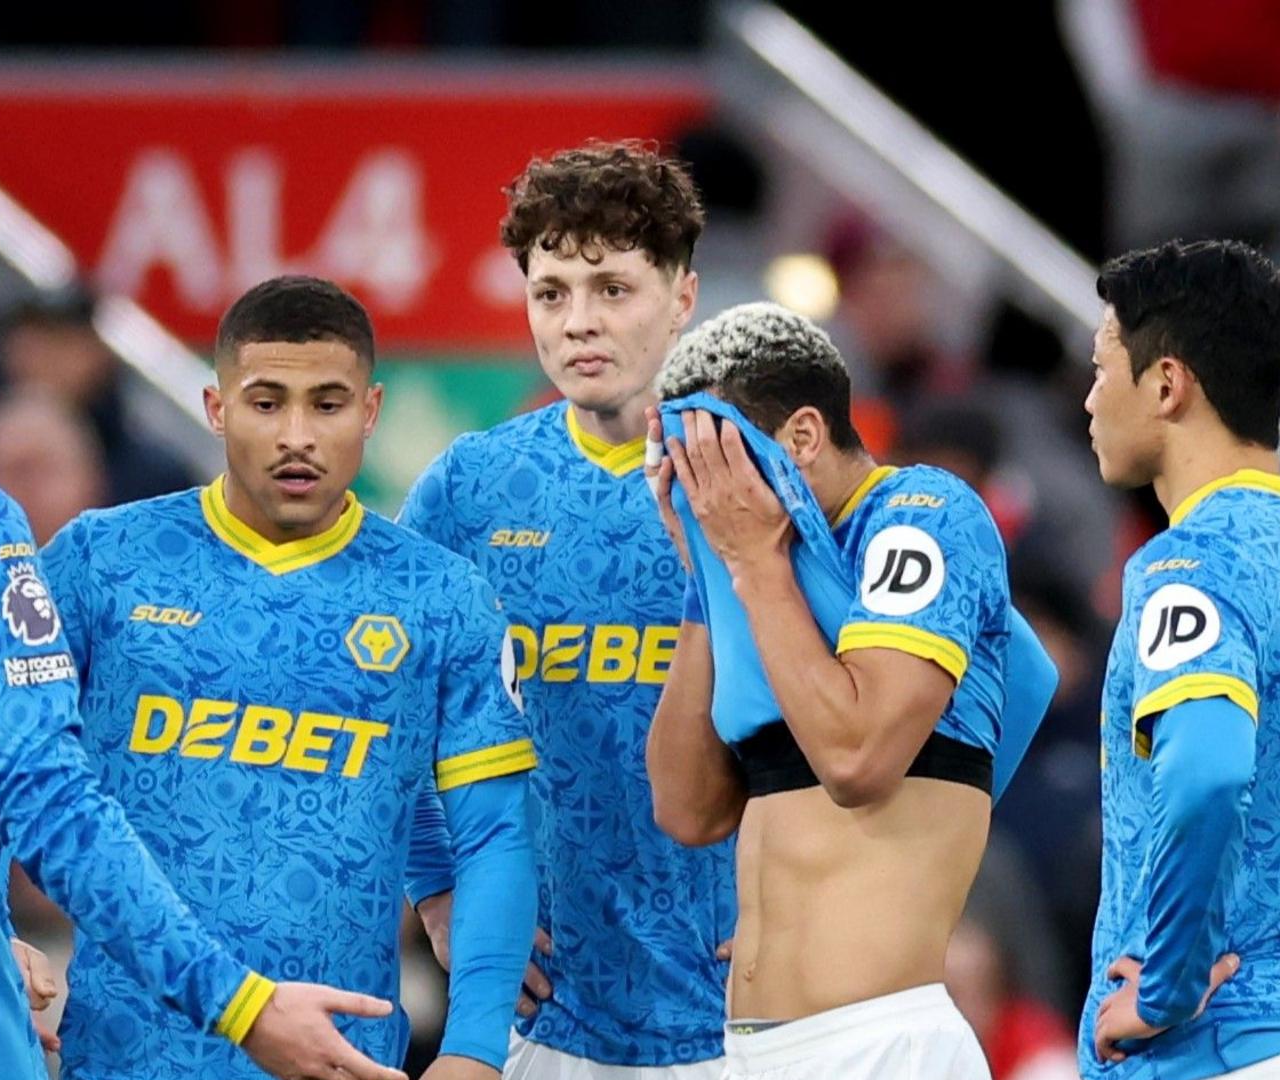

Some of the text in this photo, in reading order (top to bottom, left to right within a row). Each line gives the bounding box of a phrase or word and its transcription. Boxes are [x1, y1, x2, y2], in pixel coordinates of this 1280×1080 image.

[887, 493, 946, 508] SUDU
[489, 529, 550, 547] SUDU
[869, 548, 933, 595] JD
[129, 603, 202, 628] SUDU
[1148, 605, 1207, 657] JD
[4, 652, 69, 673] No room
[507, 624, 680, 684] DEBE
[7, 671, 29, 687] for
[128, 693, 389, 778] DEBET
